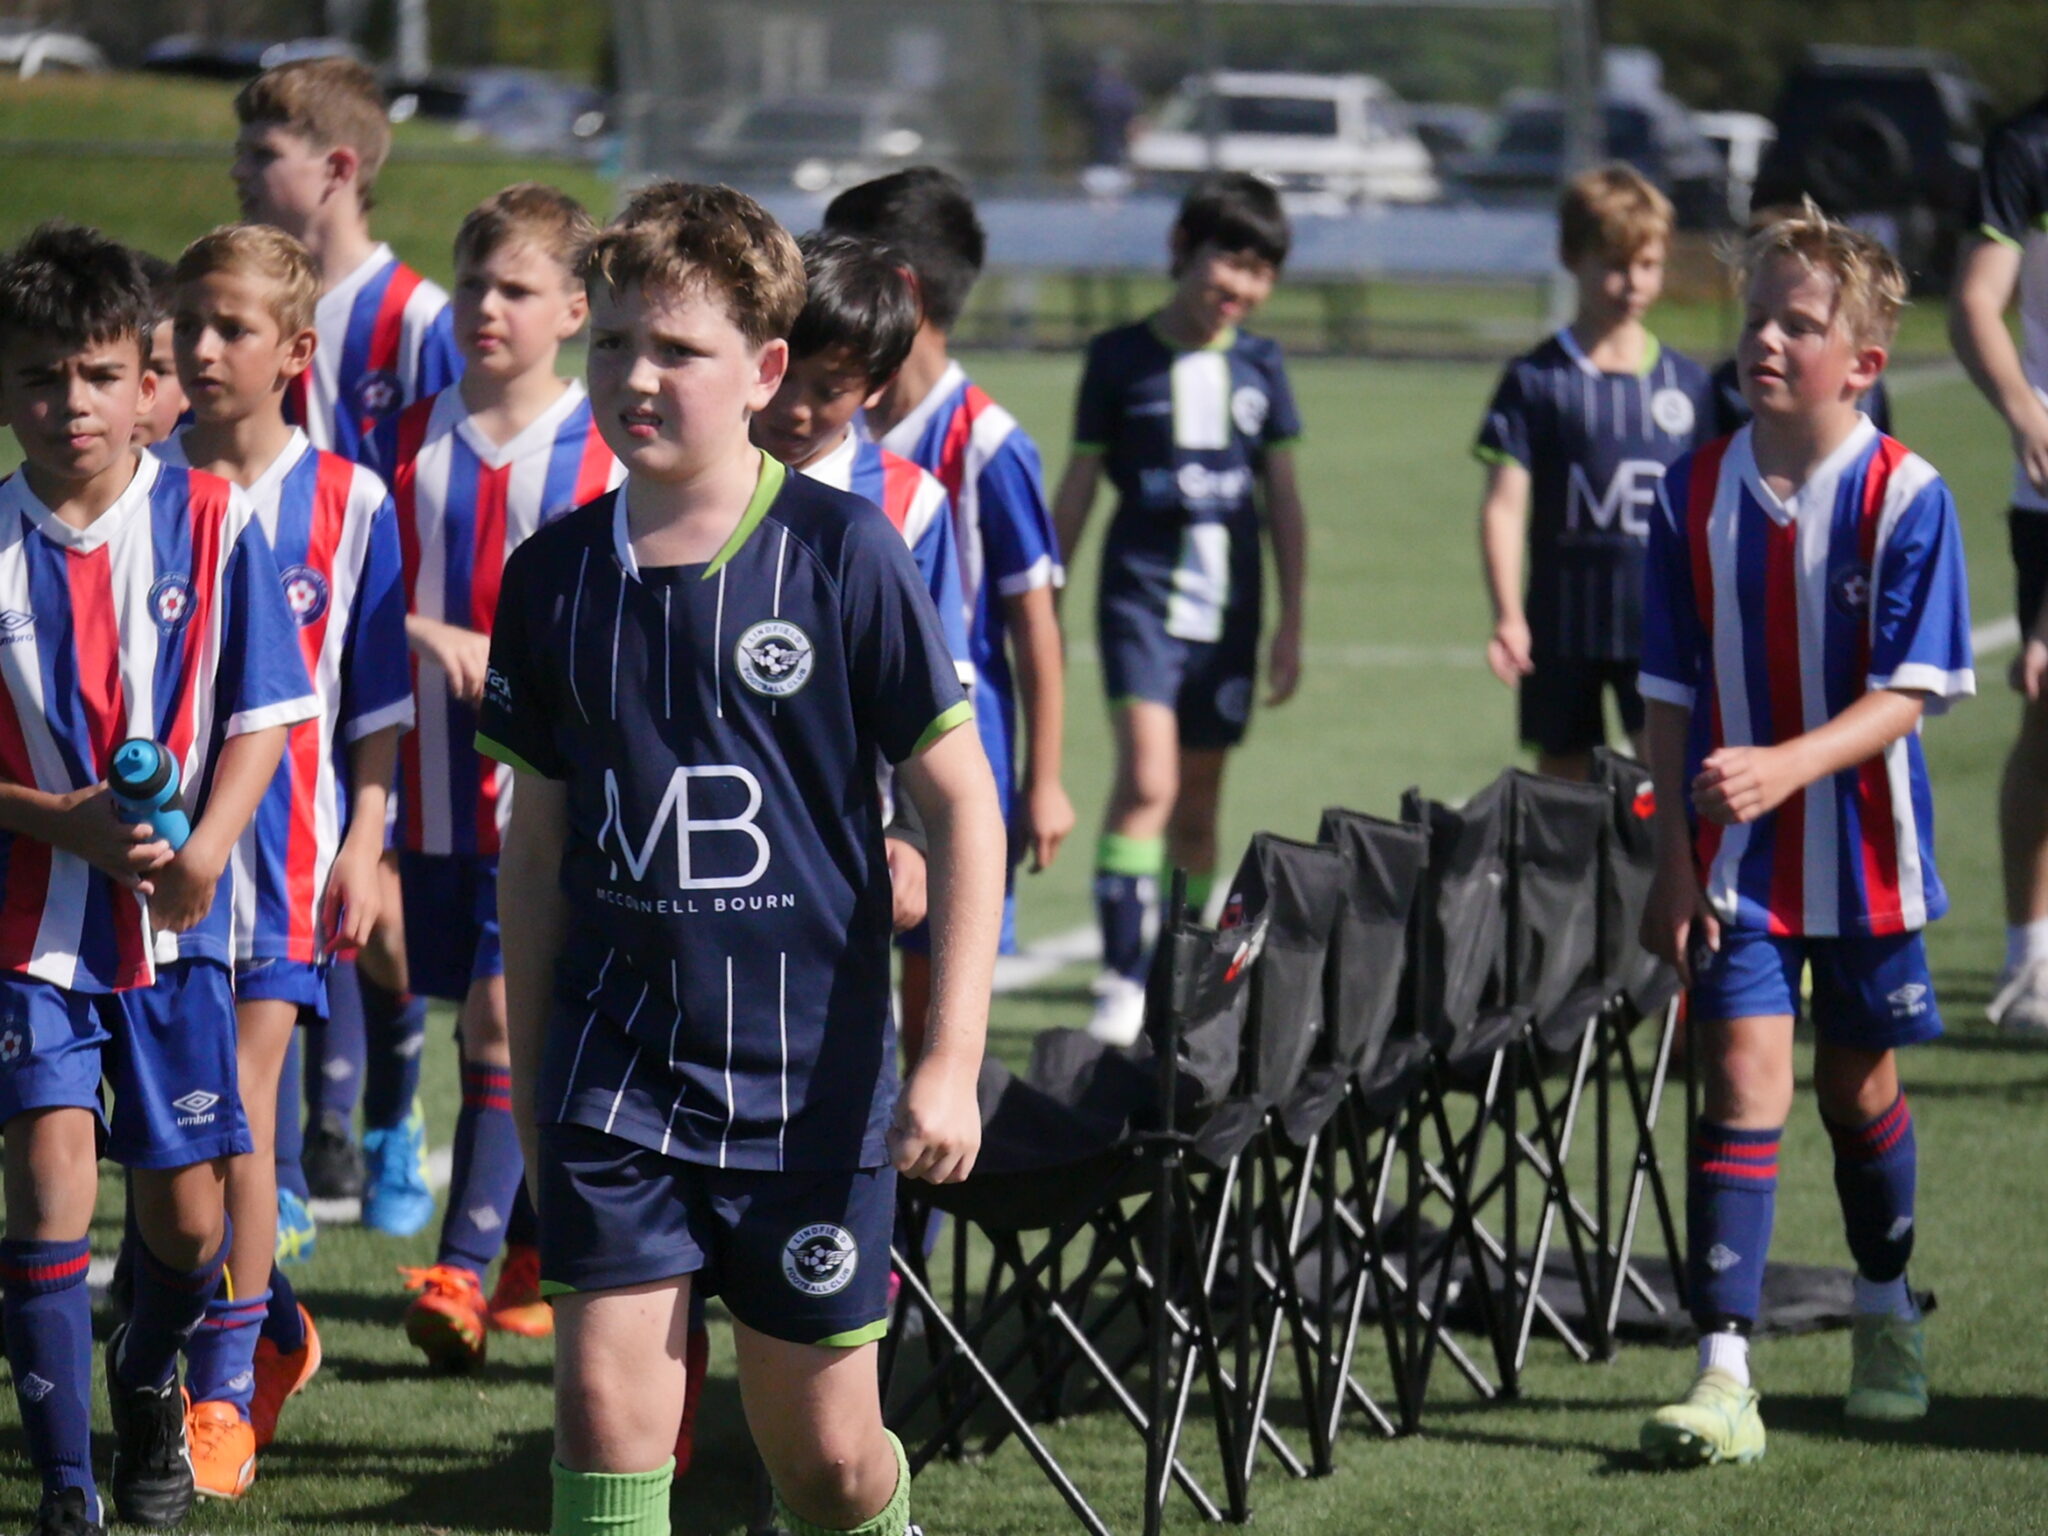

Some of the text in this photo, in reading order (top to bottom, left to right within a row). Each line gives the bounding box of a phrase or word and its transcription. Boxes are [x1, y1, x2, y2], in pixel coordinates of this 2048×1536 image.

[0, 633, 34, 647] mbro
[748, 624, 803, 644] LINDFIELD
[743, 667, 807, 693] FOOTBALL CLUB
[597, 764, 771, 890] MB
[714, 894, 796, 913] BOURN
[177, 1112, 215, 1126] umbro
[793, 1226, 847, 1244] LINDFIELD
[786, 1267, 851, 1293] FOOTBALL CLUB
